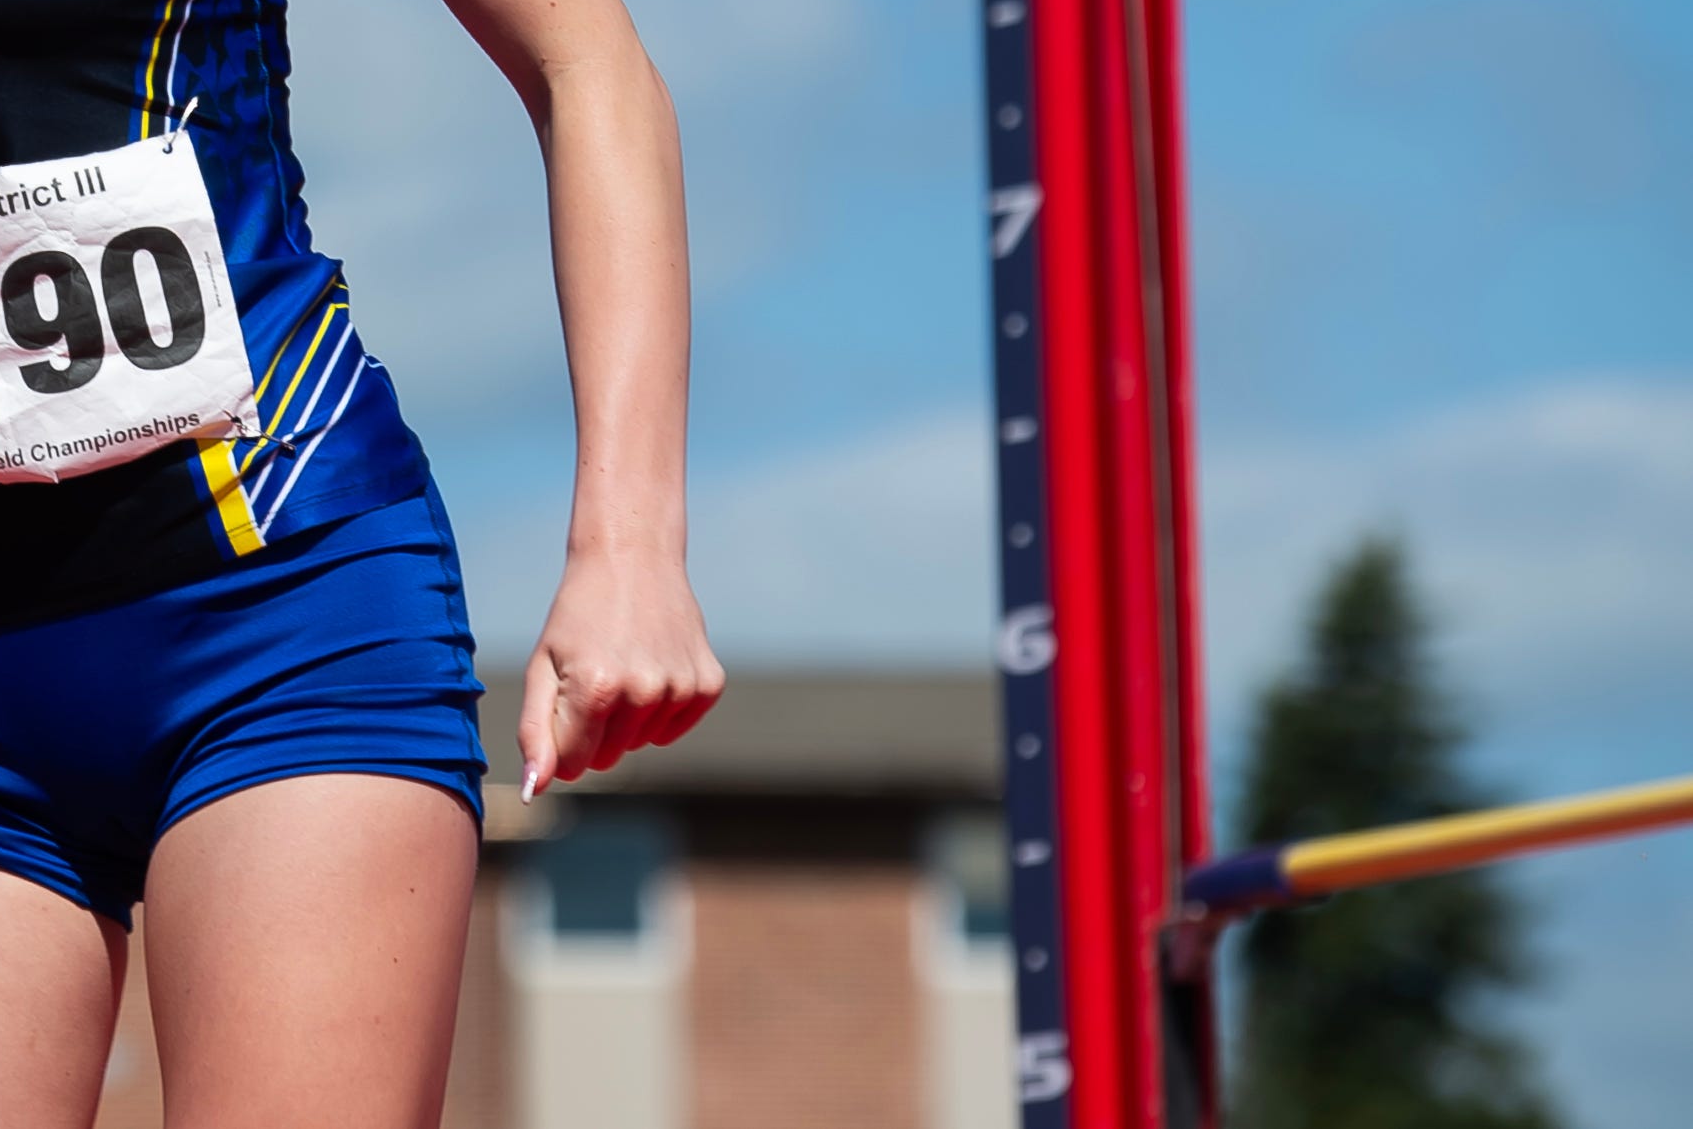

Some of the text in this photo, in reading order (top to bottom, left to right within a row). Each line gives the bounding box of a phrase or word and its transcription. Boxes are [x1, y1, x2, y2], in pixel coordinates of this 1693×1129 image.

[74, 166, 106, 197] III
[985, 182, 1045, 259] 7
[30, 412, 201, 463] Championships
[997, 602, 1058, 675] 6
[1020, 1028, 1073, 1102] 5
